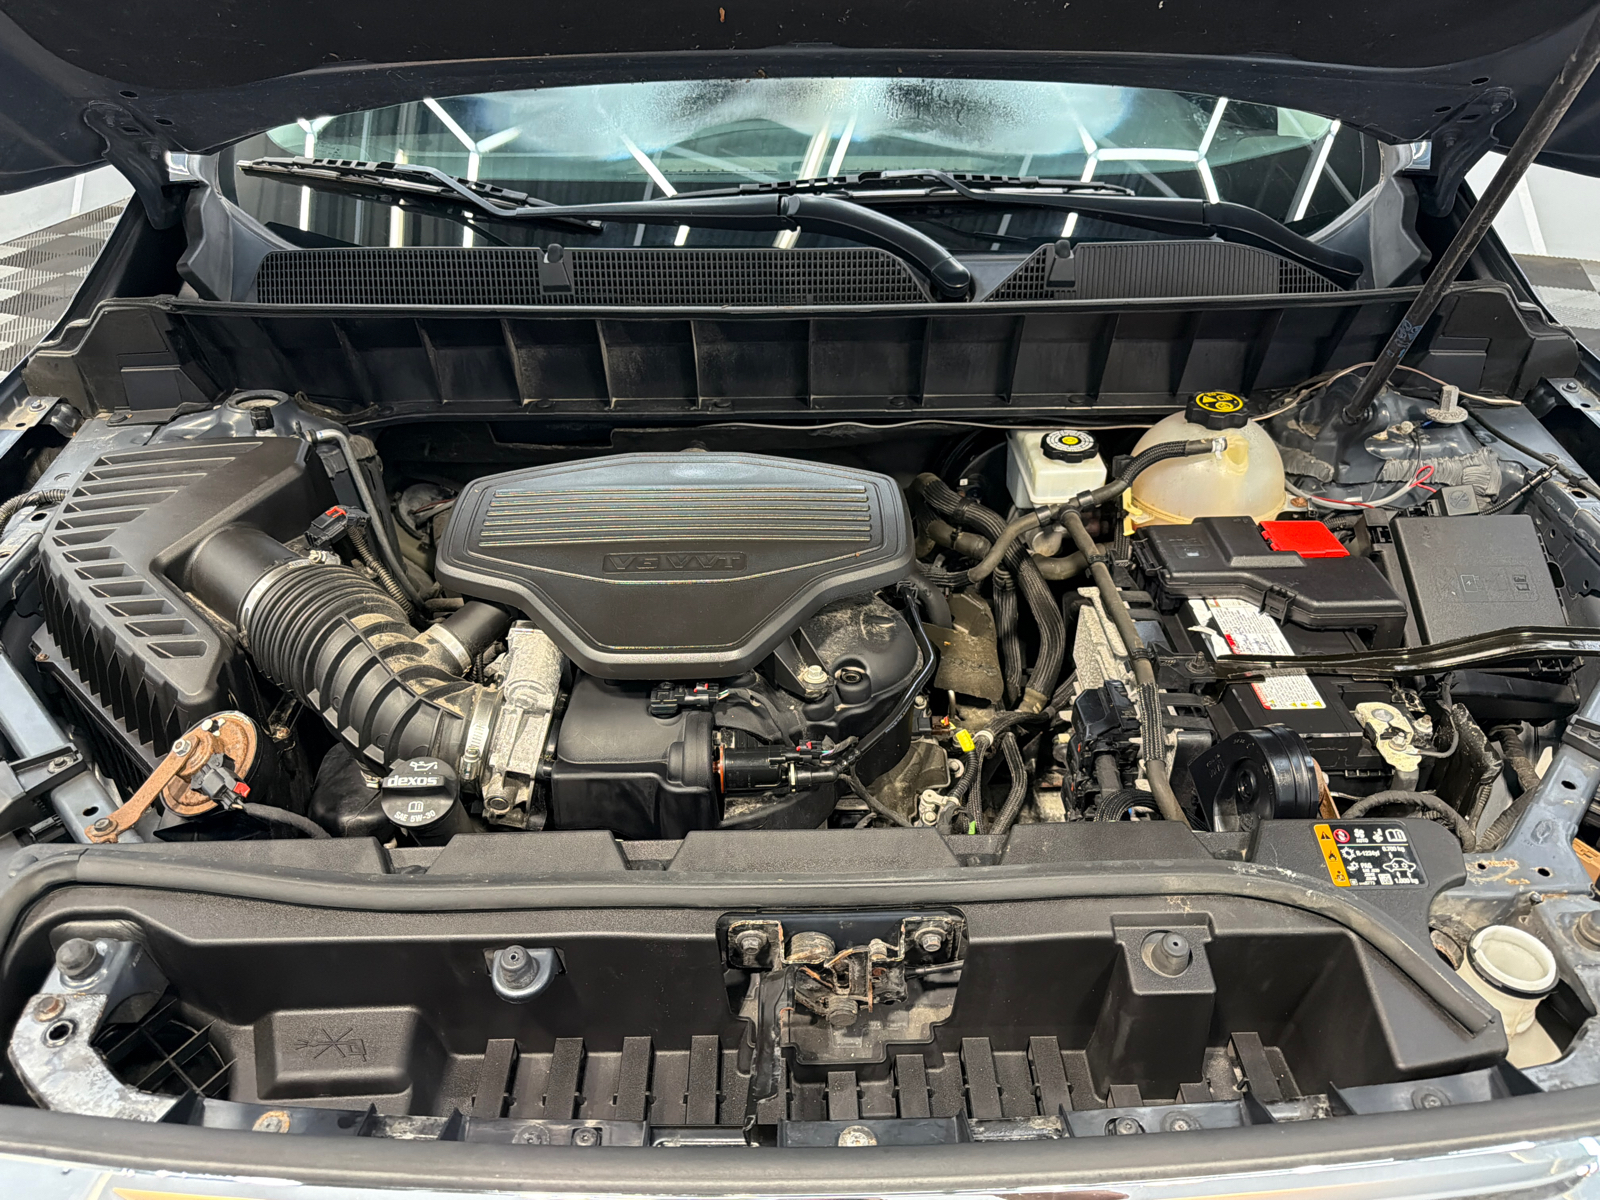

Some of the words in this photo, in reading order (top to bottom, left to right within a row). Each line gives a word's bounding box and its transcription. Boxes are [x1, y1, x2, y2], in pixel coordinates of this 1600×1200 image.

[609, 555, 659, 570] V6
[667, 555, 741, 569] VVT
[387, 775, 438, 787] dexos
[394, 811, 409, 822] SAE
[410, 810, 436, 822] 5W-30
